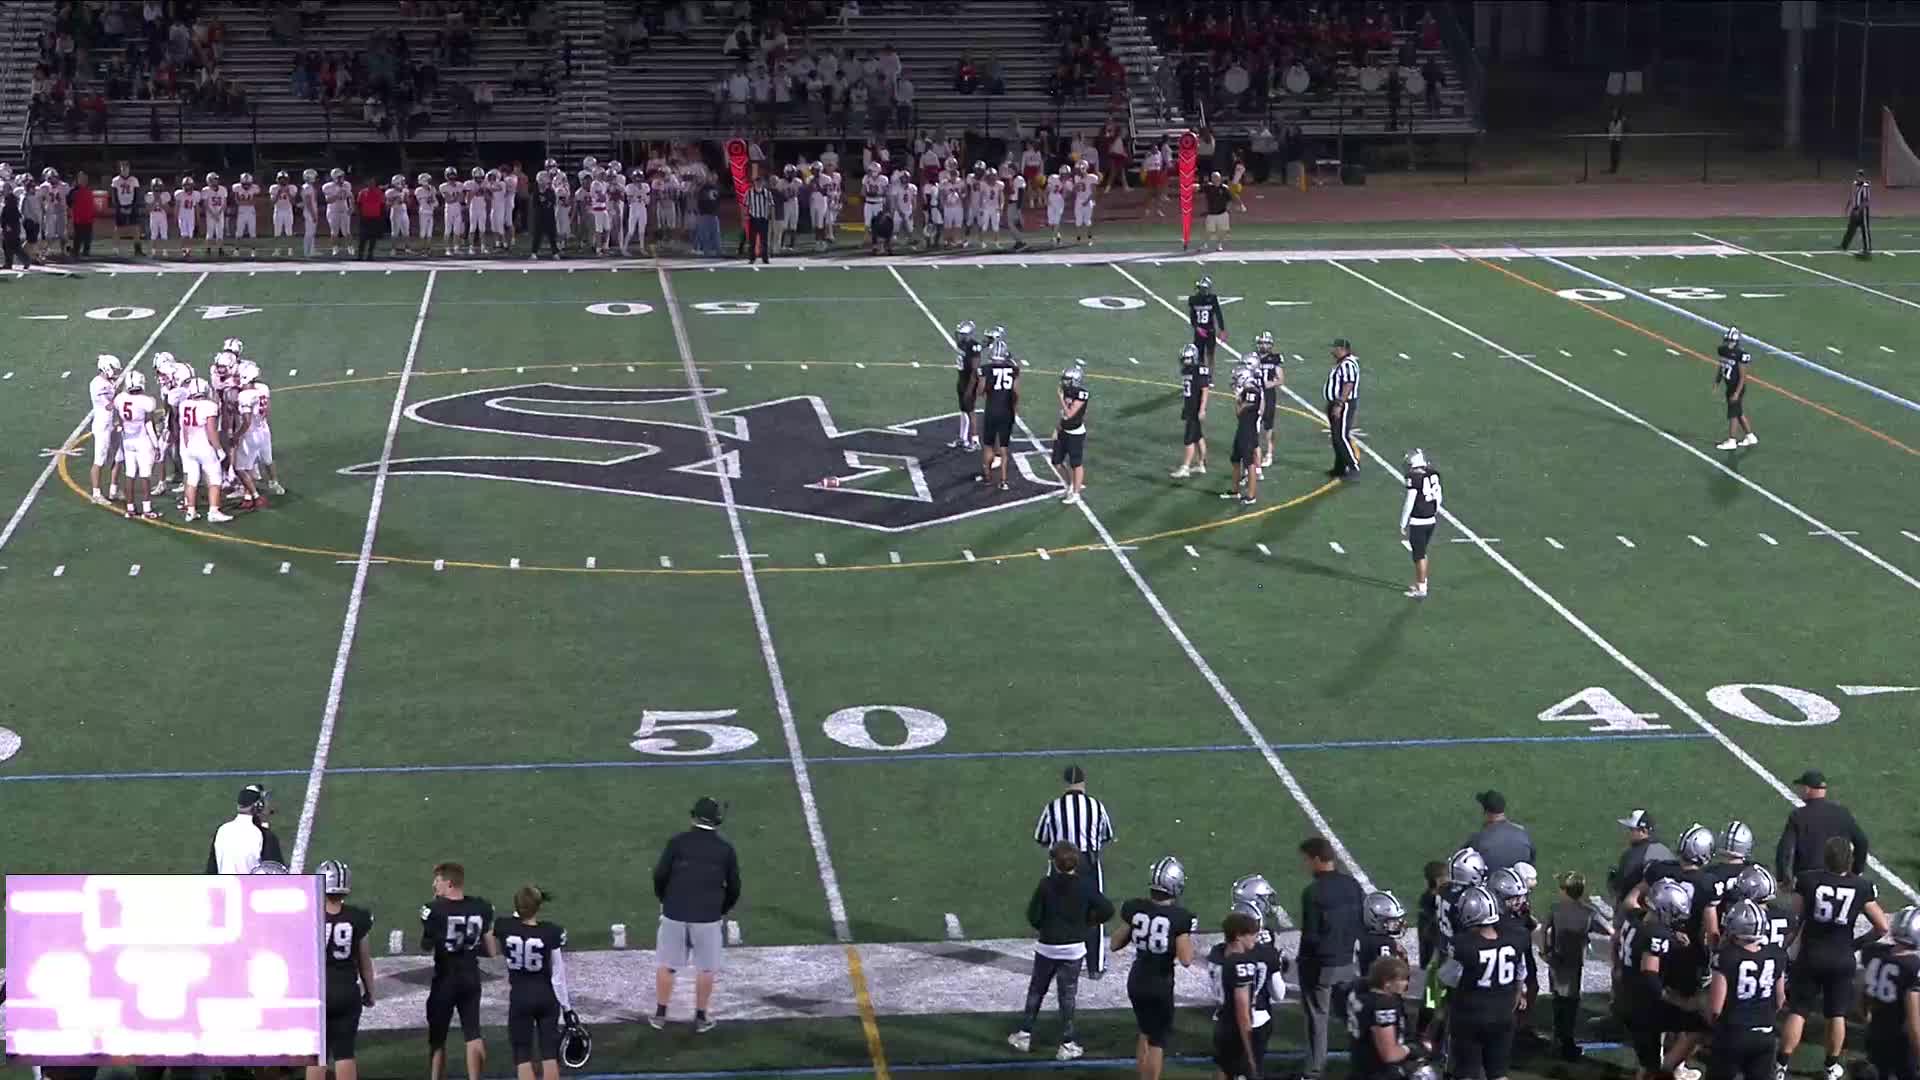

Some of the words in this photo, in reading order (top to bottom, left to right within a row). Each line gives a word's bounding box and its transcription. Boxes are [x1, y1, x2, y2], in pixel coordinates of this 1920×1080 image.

[991, 366, 1014, 390] 75
[122, 401, 134, 421] 5
[182, 406, 199, 427] 51
[1814, 885, 1856, 926] 67
[1131, 912, 1171, 955] 28
[505, 935, 545, 972] 36
[1477, 945, 1517, 988] 76
[1736, 958, 1776, 1000] 64
